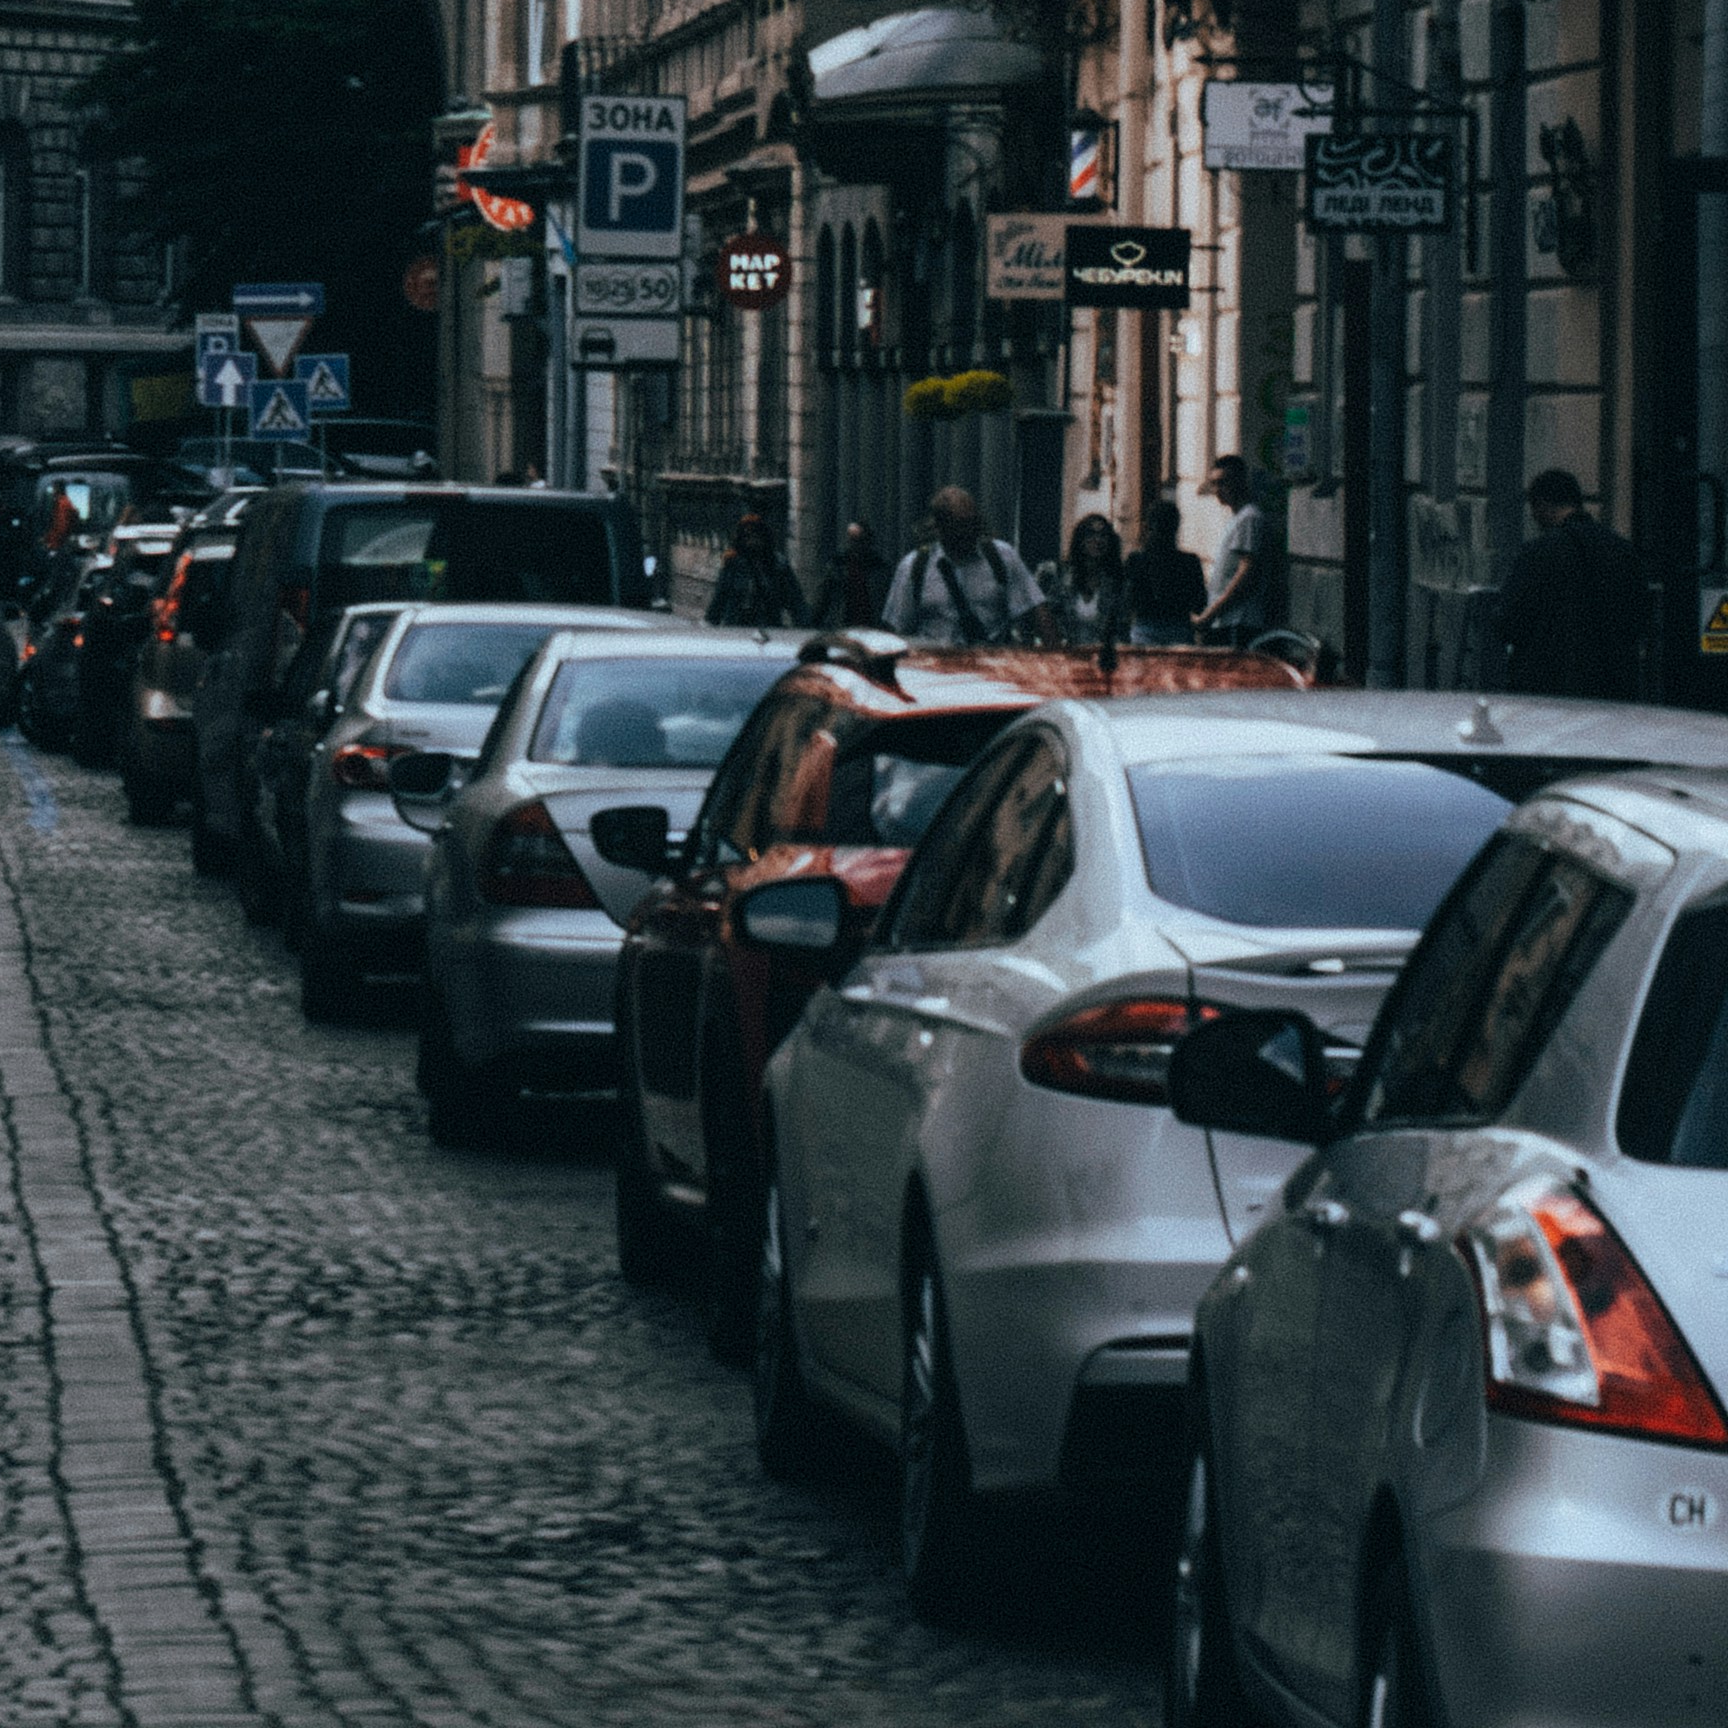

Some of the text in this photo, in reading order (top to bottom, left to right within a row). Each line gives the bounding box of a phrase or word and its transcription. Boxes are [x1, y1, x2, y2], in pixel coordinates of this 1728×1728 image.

[588, 103, 675, 132] ЗОНА
[639, 277, 670, 300] 50
[1668, 1493, 1706, 1527] CH
